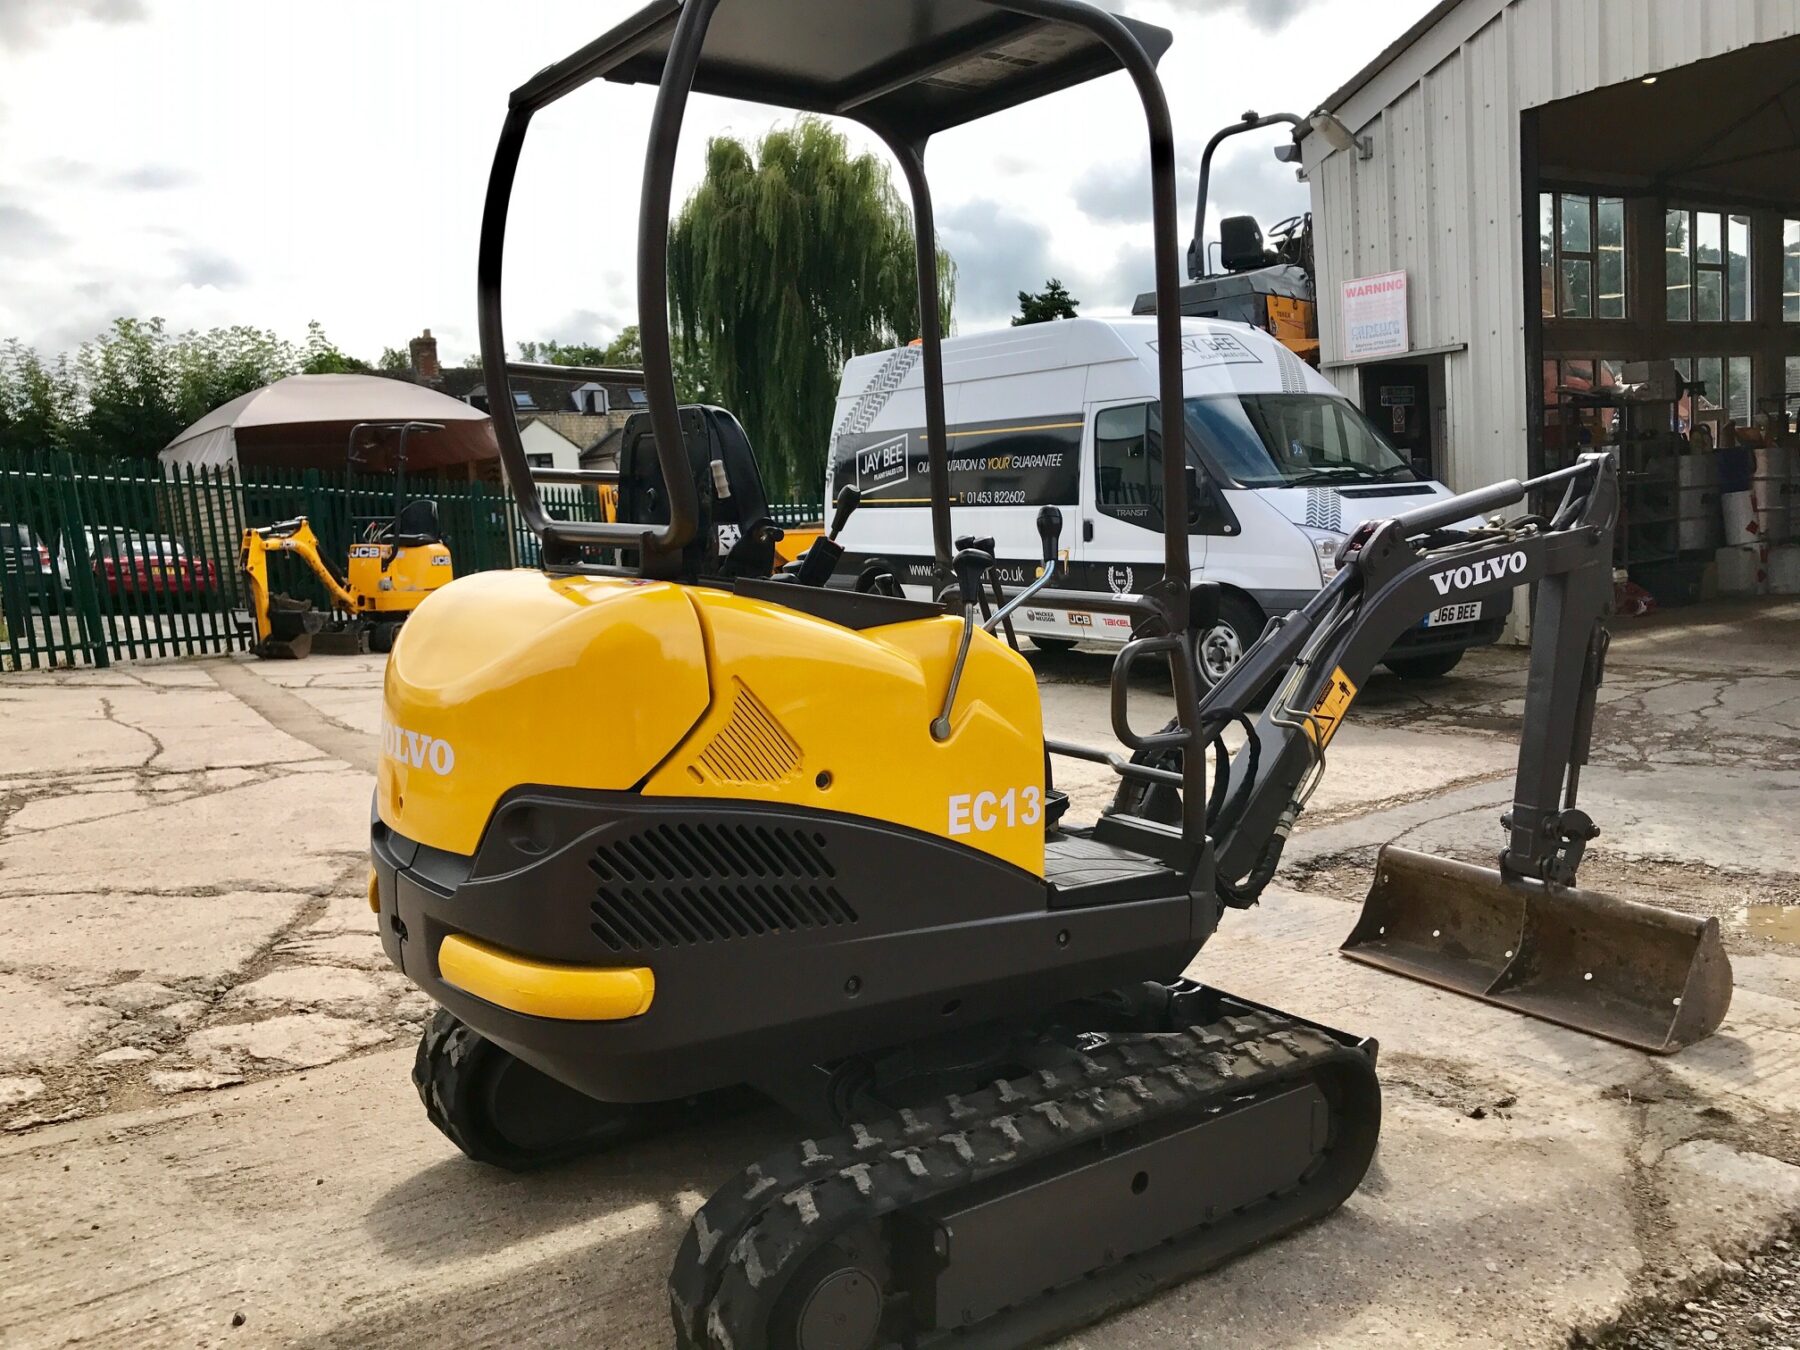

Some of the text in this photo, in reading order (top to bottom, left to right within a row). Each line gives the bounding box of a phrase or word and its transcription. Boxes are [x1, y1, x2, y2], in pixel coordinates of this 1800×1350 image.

[1345, 279, 1404, 298] WARNING
[1201, 337, 1240, 351] BEE
[861, 443, 903, 475] JAY BEE
[979, 458, 986, 470] IS
[987, 456, 1011, 470] YOUR
[1011, 453, 1063, 469] GUARANTEE
[967, 491, 992, 504] 01453
[993, 490, 1026, 503] 822602
[1116, 509, 1149, 517] TRANSIT
[351, 547, 380, 558] JCB
[432, 556, 451, 566] JCB
[1429, 551, 1527, 595] VOLVO
[1070, 613, 1091, 625] JCB
[1434, 603, 1478, 623] J66 BEE
[948, 785, 1041, 835] EC13
